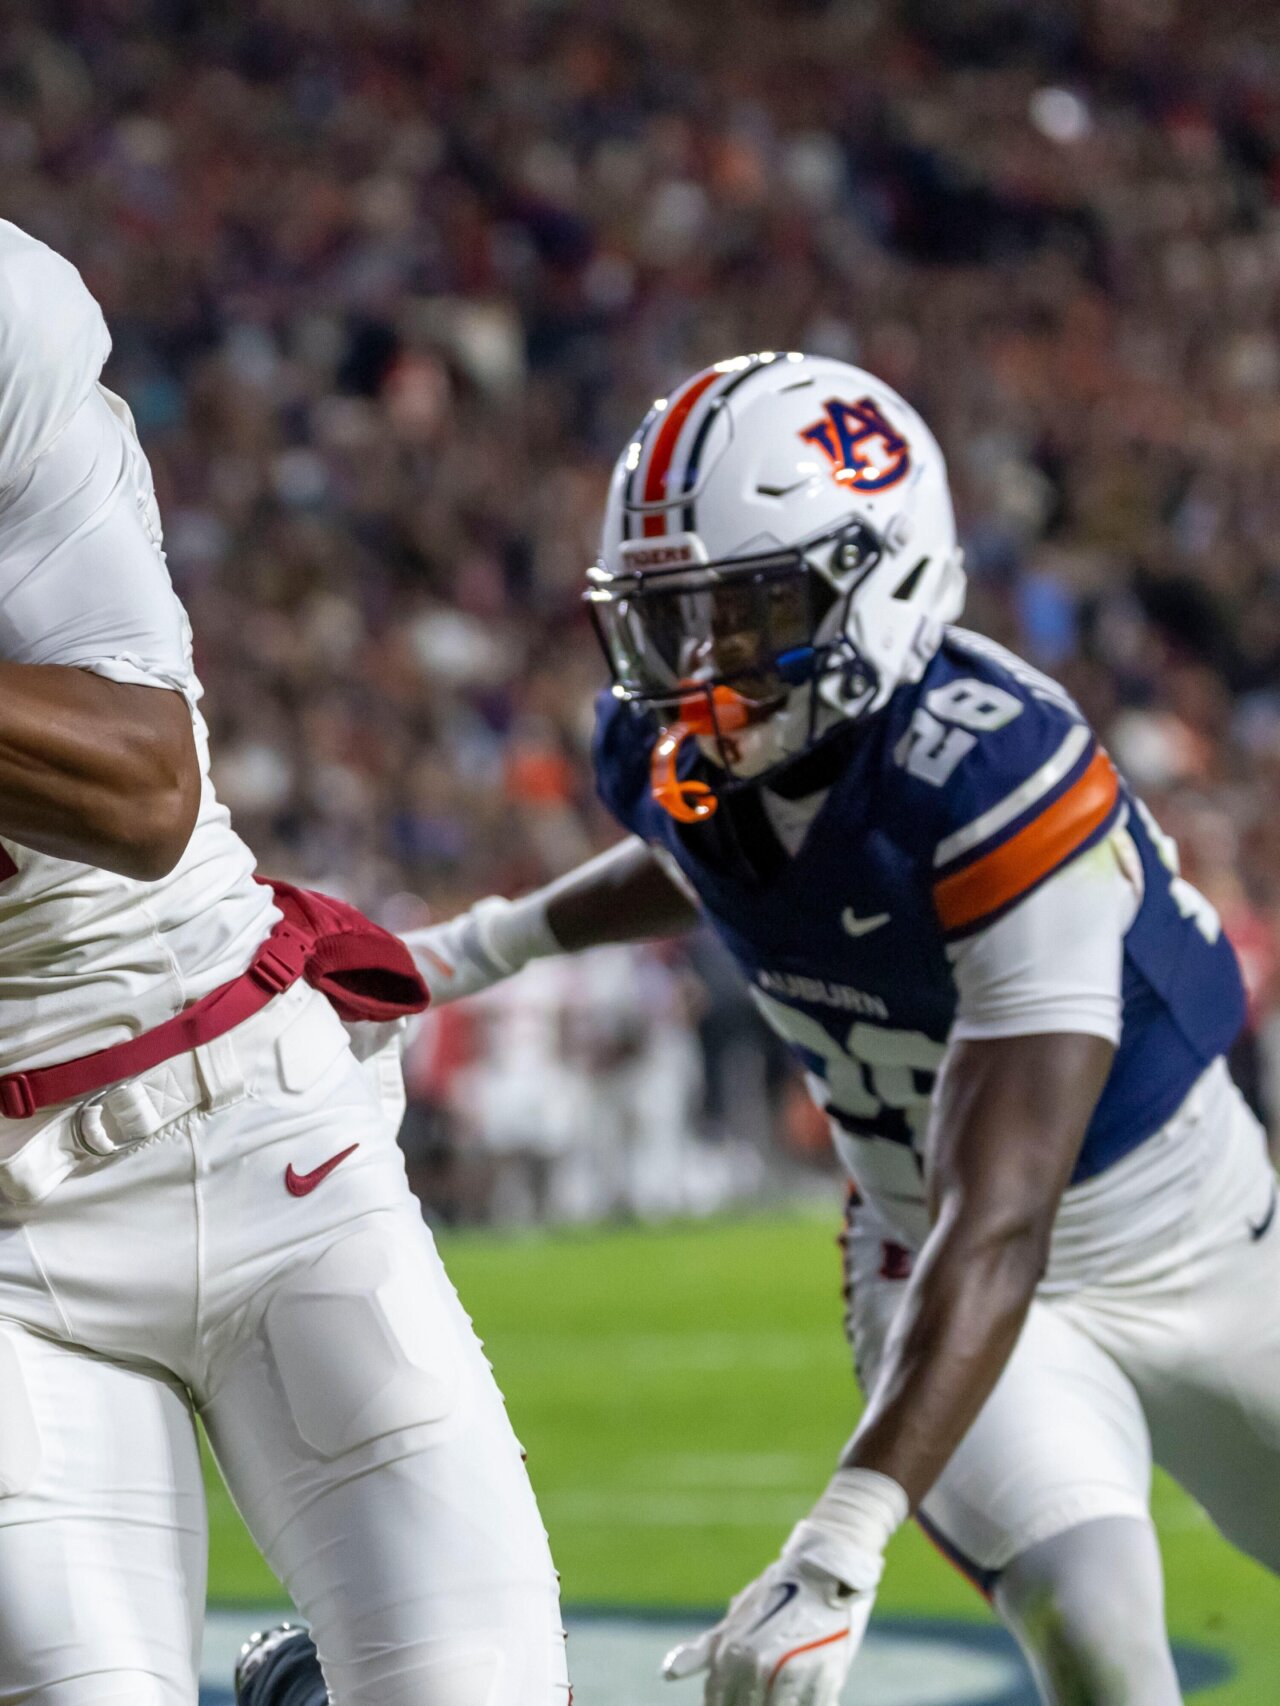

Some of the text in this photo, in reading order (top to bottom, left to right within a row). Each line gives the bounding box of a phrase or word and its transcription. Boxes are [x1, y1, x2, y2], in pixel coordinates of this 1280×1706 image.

[623, 545, 691, 569] TIGERS
[894, 677, 1024, 788] 28
[759, 968, 889, 1020] AUBURN
